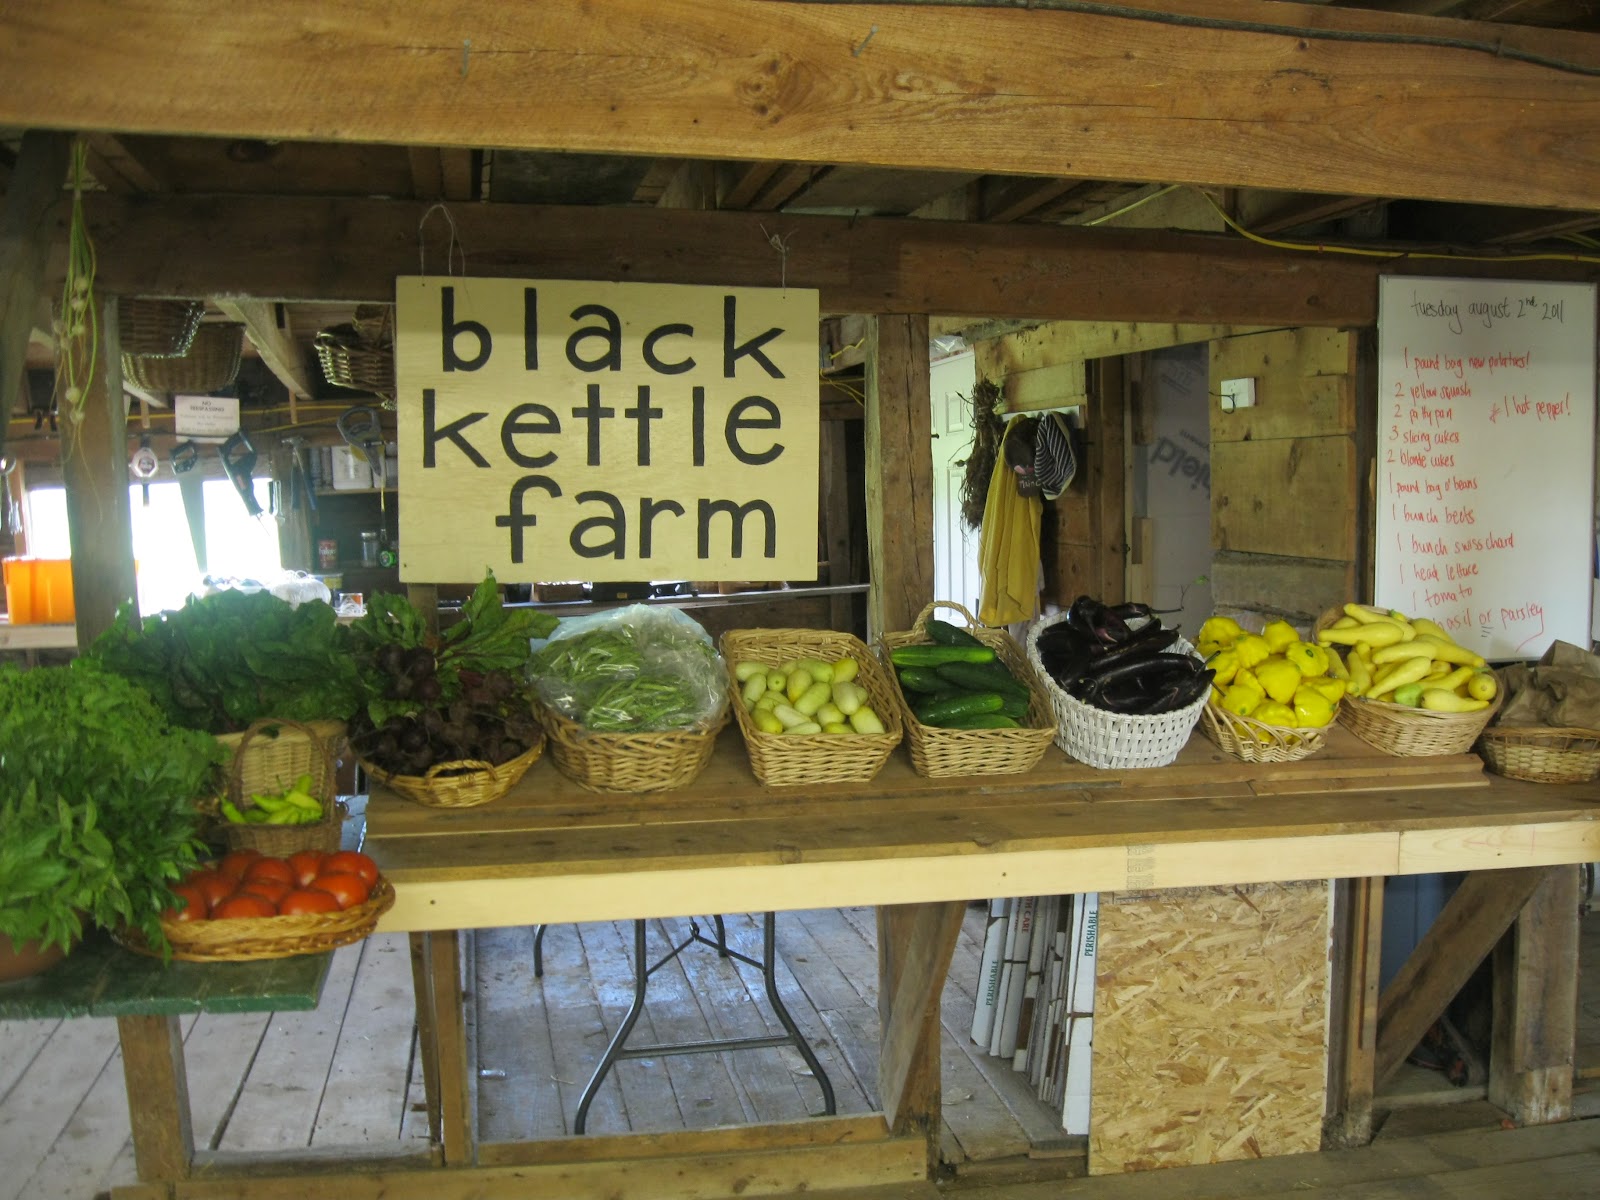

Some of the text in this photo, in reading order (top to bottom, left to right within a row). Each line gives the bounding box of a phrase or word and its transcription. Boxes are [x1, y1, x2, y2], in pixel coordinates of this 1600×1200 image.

[1411, 290, 1462, 334] tuesday
[1469, 297, 1510, 328] august
[441, 286, 786, 379] black
[1414, 354, 1440, 379] pound
[1445, 355, 1463, 378] bag
[1469, 356, 1485, 370] new
[1395, 381, 1471, 406] 2 yellow squash
[1394, 404, 1402, 417] 2
[1513, 395, 1530, 414] hot
[1536, 392, 1570, 421] pepper!
[422, 384, 785, 468] kettle
[1389, 426, 1459, 450] 3 slicing cukes
[1387, 449, 1455, 467] 2 blonde cukes
[1397, 480, 1420, 499] pound
[1425, 479, 1442, 500] bag
[1453, 476, 1478, 490] beans
[495, 475, 776, 563] farm
[1404, 504, 1438, 523] bunch
[1445, 506, 1475, 524] beets
[1412, 534, 1447, 556] bunch
[1414, 565, 1439, 582] head
[1446, 562, 1479, 581] lettuce
[1425, 584, 1473, 608] tomato
[1479, 609, 1492, 626] or
[1501, 603, 1544, 653] parsley
[1085, 910, 1098, 957] PERISHABLE
[986, 961, 999, 1006] PERISHABLE
